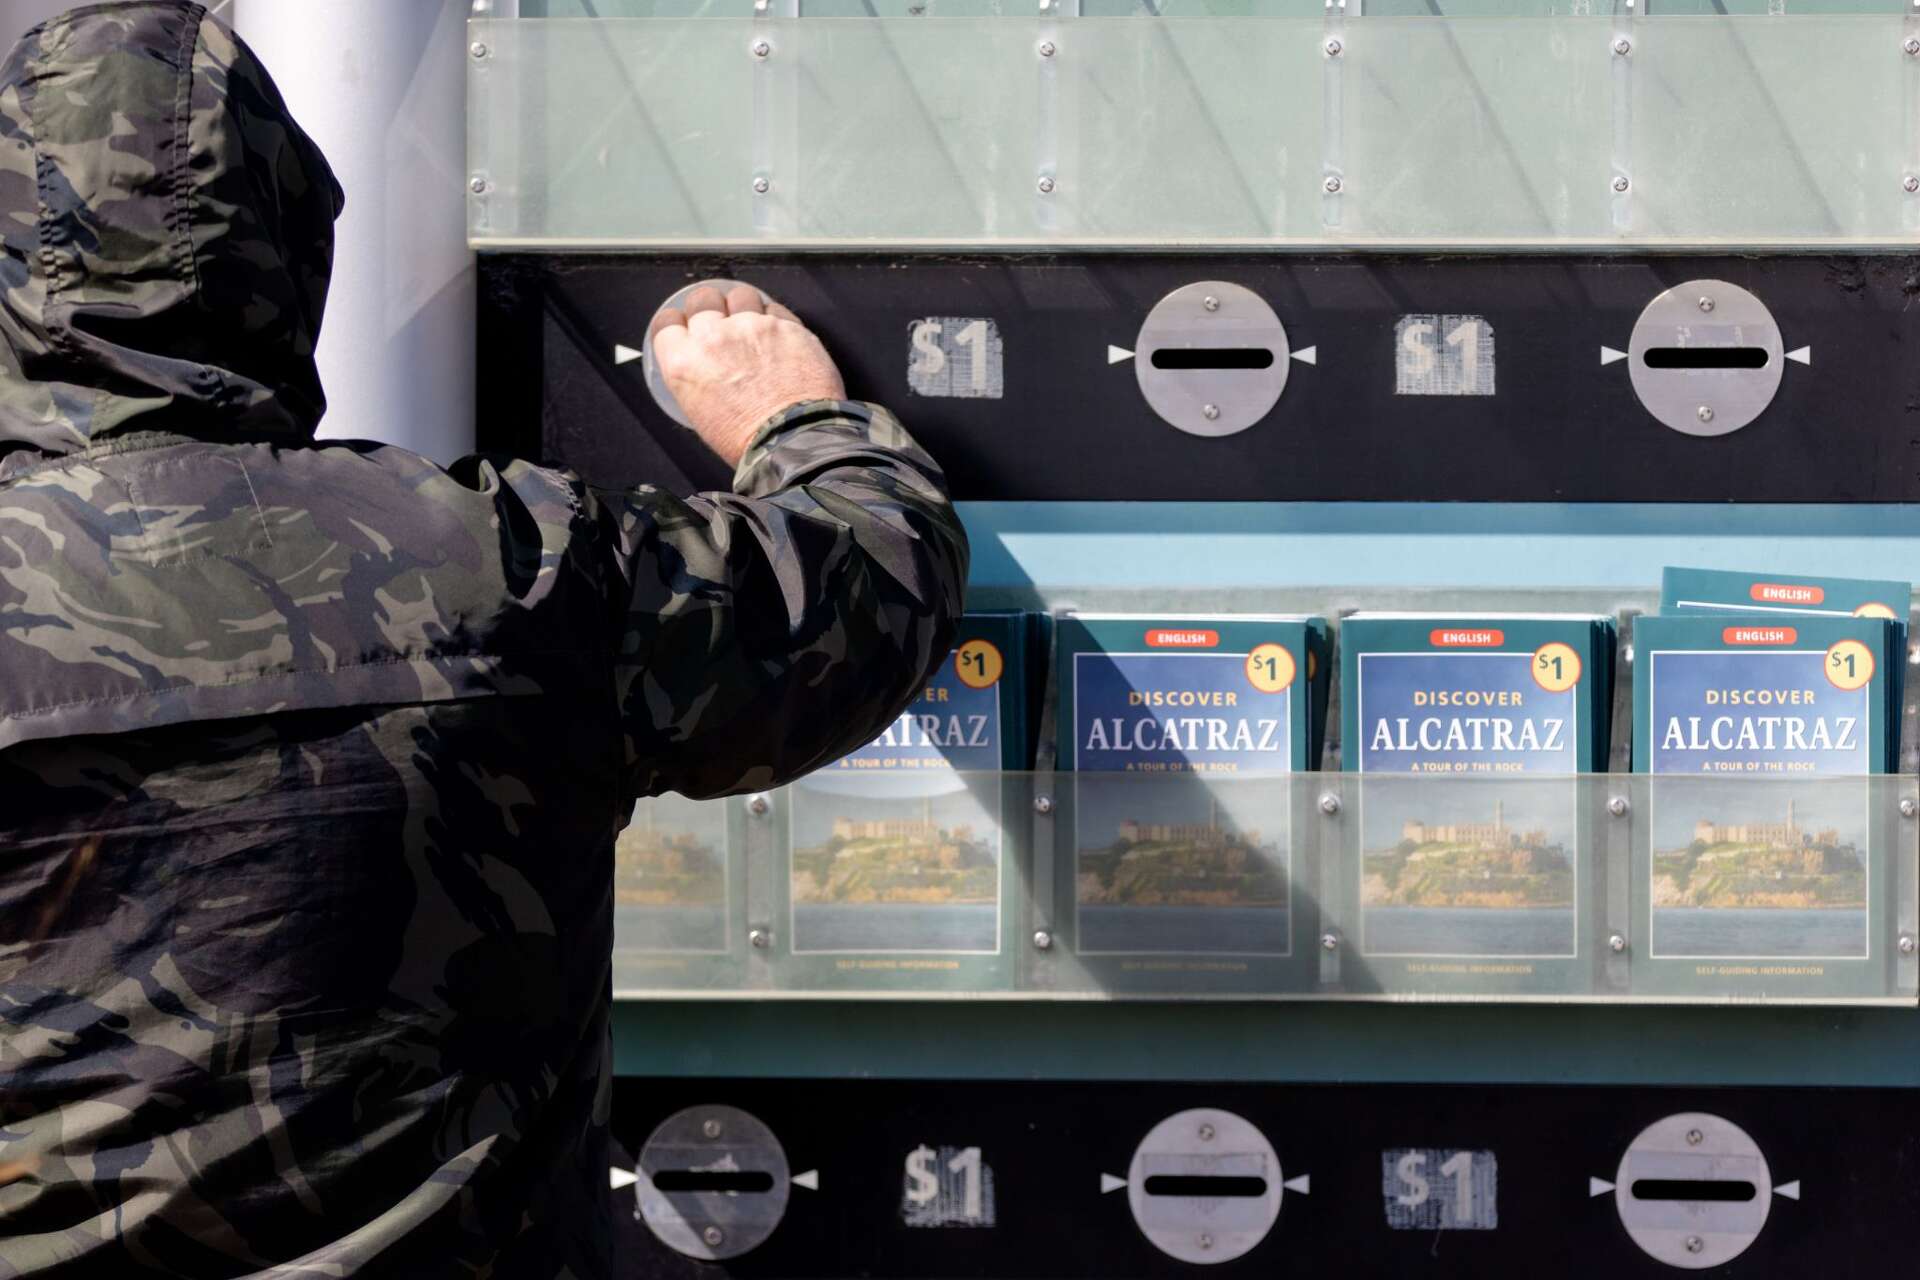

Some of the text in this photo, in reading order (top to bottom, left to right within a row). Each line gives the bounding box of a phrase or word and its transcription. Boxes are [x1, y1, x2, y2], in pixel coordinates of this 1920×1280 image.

[911, 318, 987, 391] $1
[1402, 319, 1478, 392] $1
[1762, 587, 1812, 600] ENGLISH
[1157, 633, 1207, 643] ENGLISH
[1442, 633, 1492, 643] ENGLISH
[1735, 631, 1784, 641] ENGLISH
[962, 650, 985, 677] $1
[1253, 654, 1276, 681] $1
[1538, 653, 1562, 680] $1
[1831, 652, 1855, 678] $1
[1129, 691, 1237, 706] DISCOVER
[1414, 691, 1523, 706] DISCOVER
[1706, 690, 1815, 705] DISCOVER
[1086, 718, 1279, 751] ALCATRAZ
[1370, 717, 1564, 751] ALCATRAZ
[1662, 717, 1857, 751] ALCATRAZ
[1411, 762, 1419, 771] A
[1423, 762, 1451, 771] TOUR
[1455, 762, 1468, 771] OF
[1472, 762, 1490, 771] THE
[1703, 761, 1816, 771] A TOUR OF THE ROCK
[1760, 966, 1824, 976] INFORMATION
[905, 1143, 981, 1217] $1
[1398, 1148, 1472, 1221] $1
